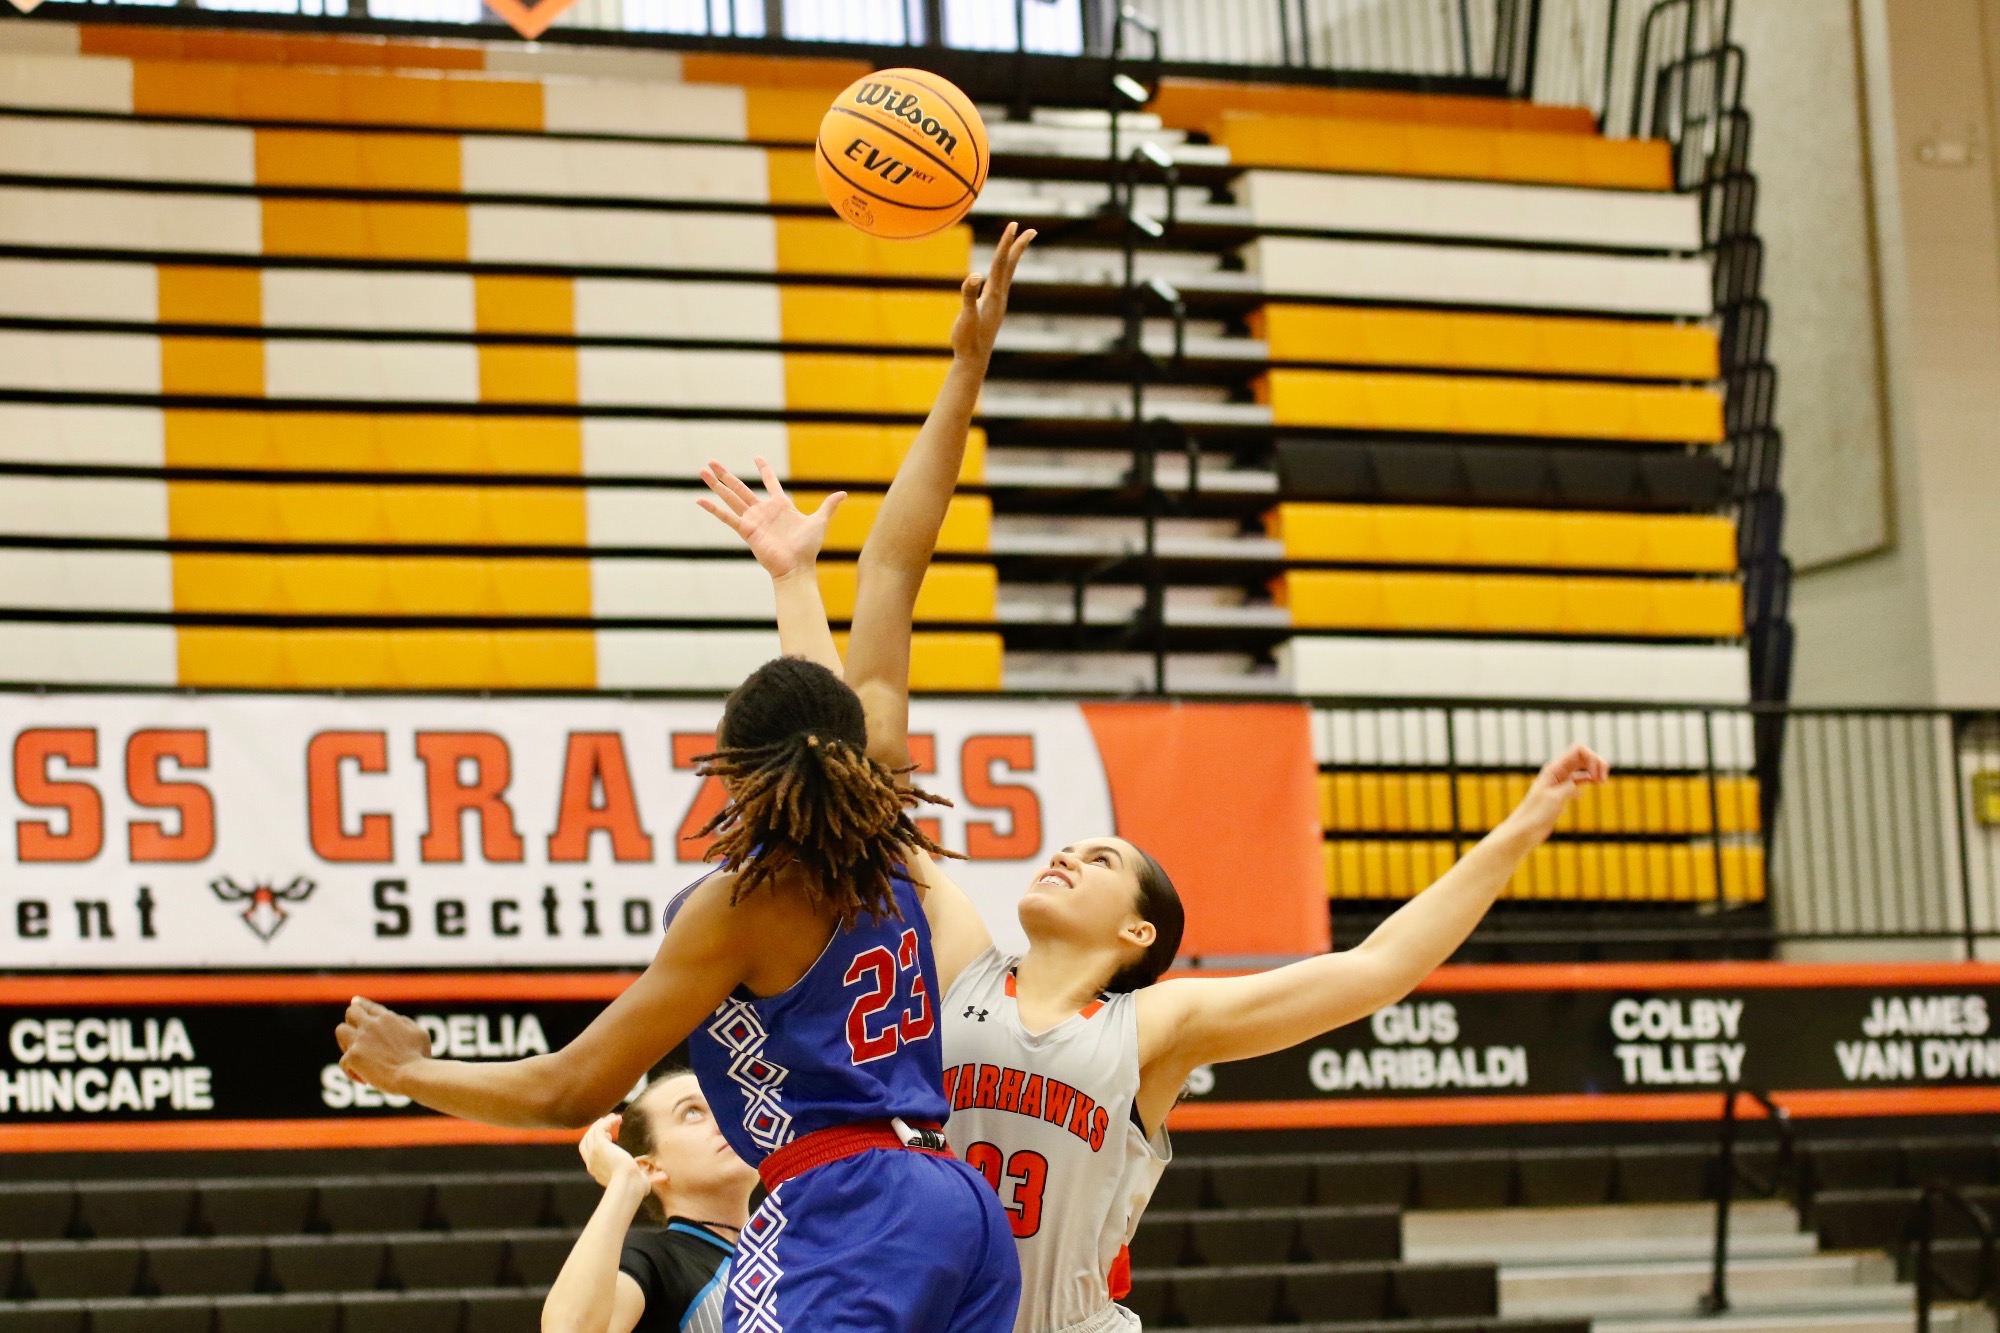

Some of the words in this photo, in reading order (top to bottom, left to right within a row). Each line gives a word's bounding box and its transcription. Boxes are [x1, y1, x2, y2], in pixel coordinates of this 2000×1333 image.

[855, 82, 958, 156] Wilson
[844, 137, 914, 185] EVO
[913, 169, 937, 184] NXT
[12, 727, 216, 864] SS
[16, 886, 157, 938] ent
[373, 878, 654, 937] Sectio
[843, 927, 935, 1066] 23
[1610, 998, 1745, 1041] COLBY
[1862, 994, 1991, 1037] JAMES
[9, 1017, 195, 1063] CECILIA
[1371, 1001, 1459, 1045] GUS
[1309, 1045, 1529, 1091] GARIBALDI
[1614, 1043, 1746, 1085] TILLEY
[1833, 1039, 1916, 1081] VAN
[0, 1066, 214, 1113] HINCAPIE
